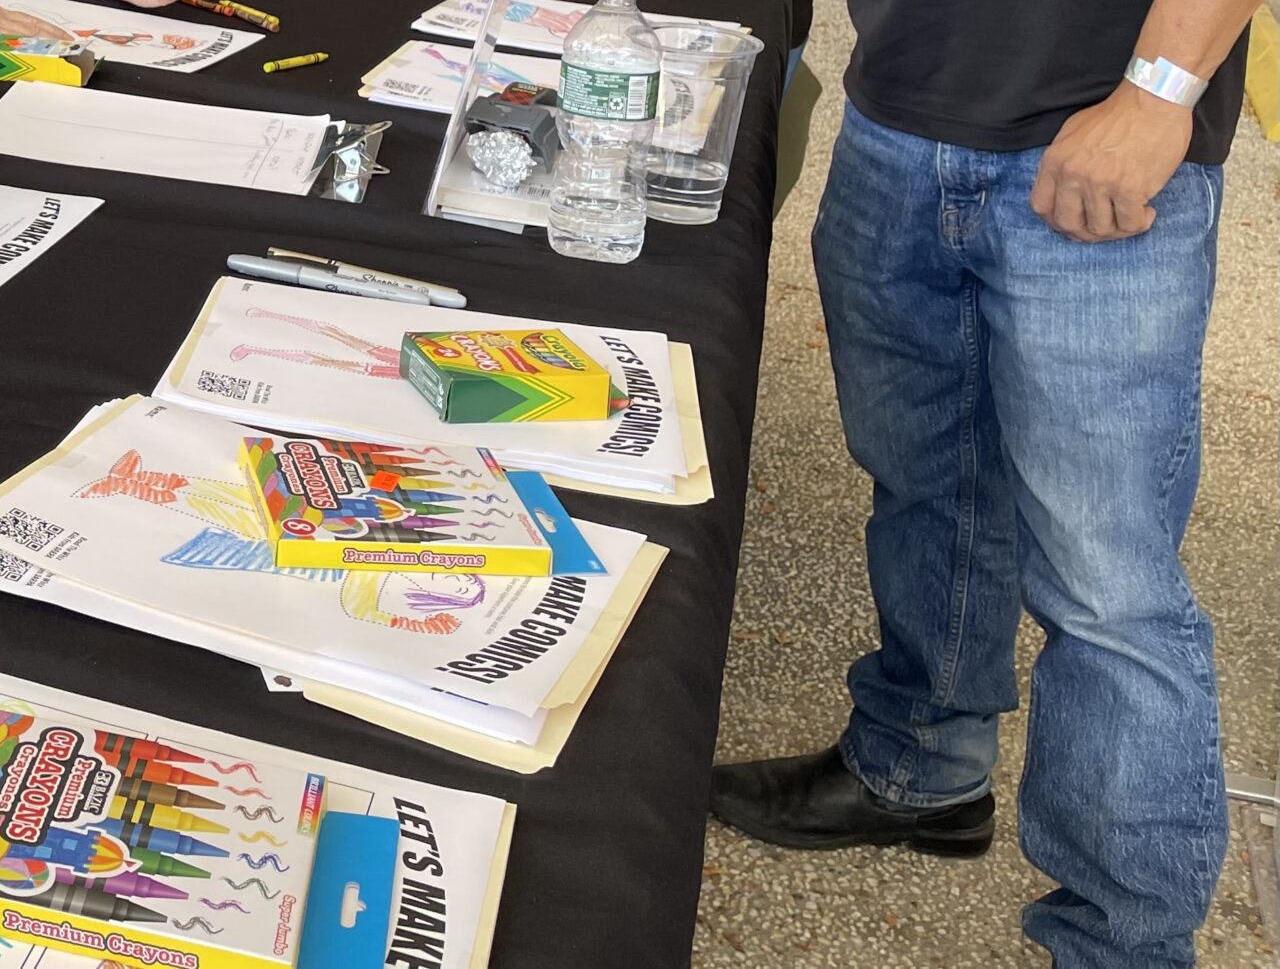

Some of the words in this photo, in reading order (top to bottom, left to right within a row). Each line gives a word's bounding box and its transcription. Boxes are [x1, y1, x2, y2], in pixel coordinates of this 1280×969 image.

[12, 218, 55, 246] MAKE
[362, 273, 399, 288] Sharpie
[449, 333, 504, 373] CRAYONS
[539, 333, 587, 372] Crayola
[621, 365, 662, 404] MAKE
[595, 403, 663, 457] COMICS!
[280, 454, 302, 494] Crayones
[290, 442, 336, 509] CRAYONS
[322, 458, 347, 493] Premium
[290, 521, 311, 535] 8
[343, 547, 419, 567] Premium
[420, 551, 486, 568] Crayons
[532, 576, 588, 625] MAKE
[434, 618, 567, 684] COMICS!
[7, 729, 77, 843] CRAYONS
[55, 758, 94, 819] Premium
[88, 786, 110, 815] BAZIC
[393, 796, 444, 878] LET'S
[282, 894, 296, 924] Super
[385, 877, 447, 969] MAKE
[4, 910, 105, 951] Premium
[107, 935, 199, 969] Crayons
